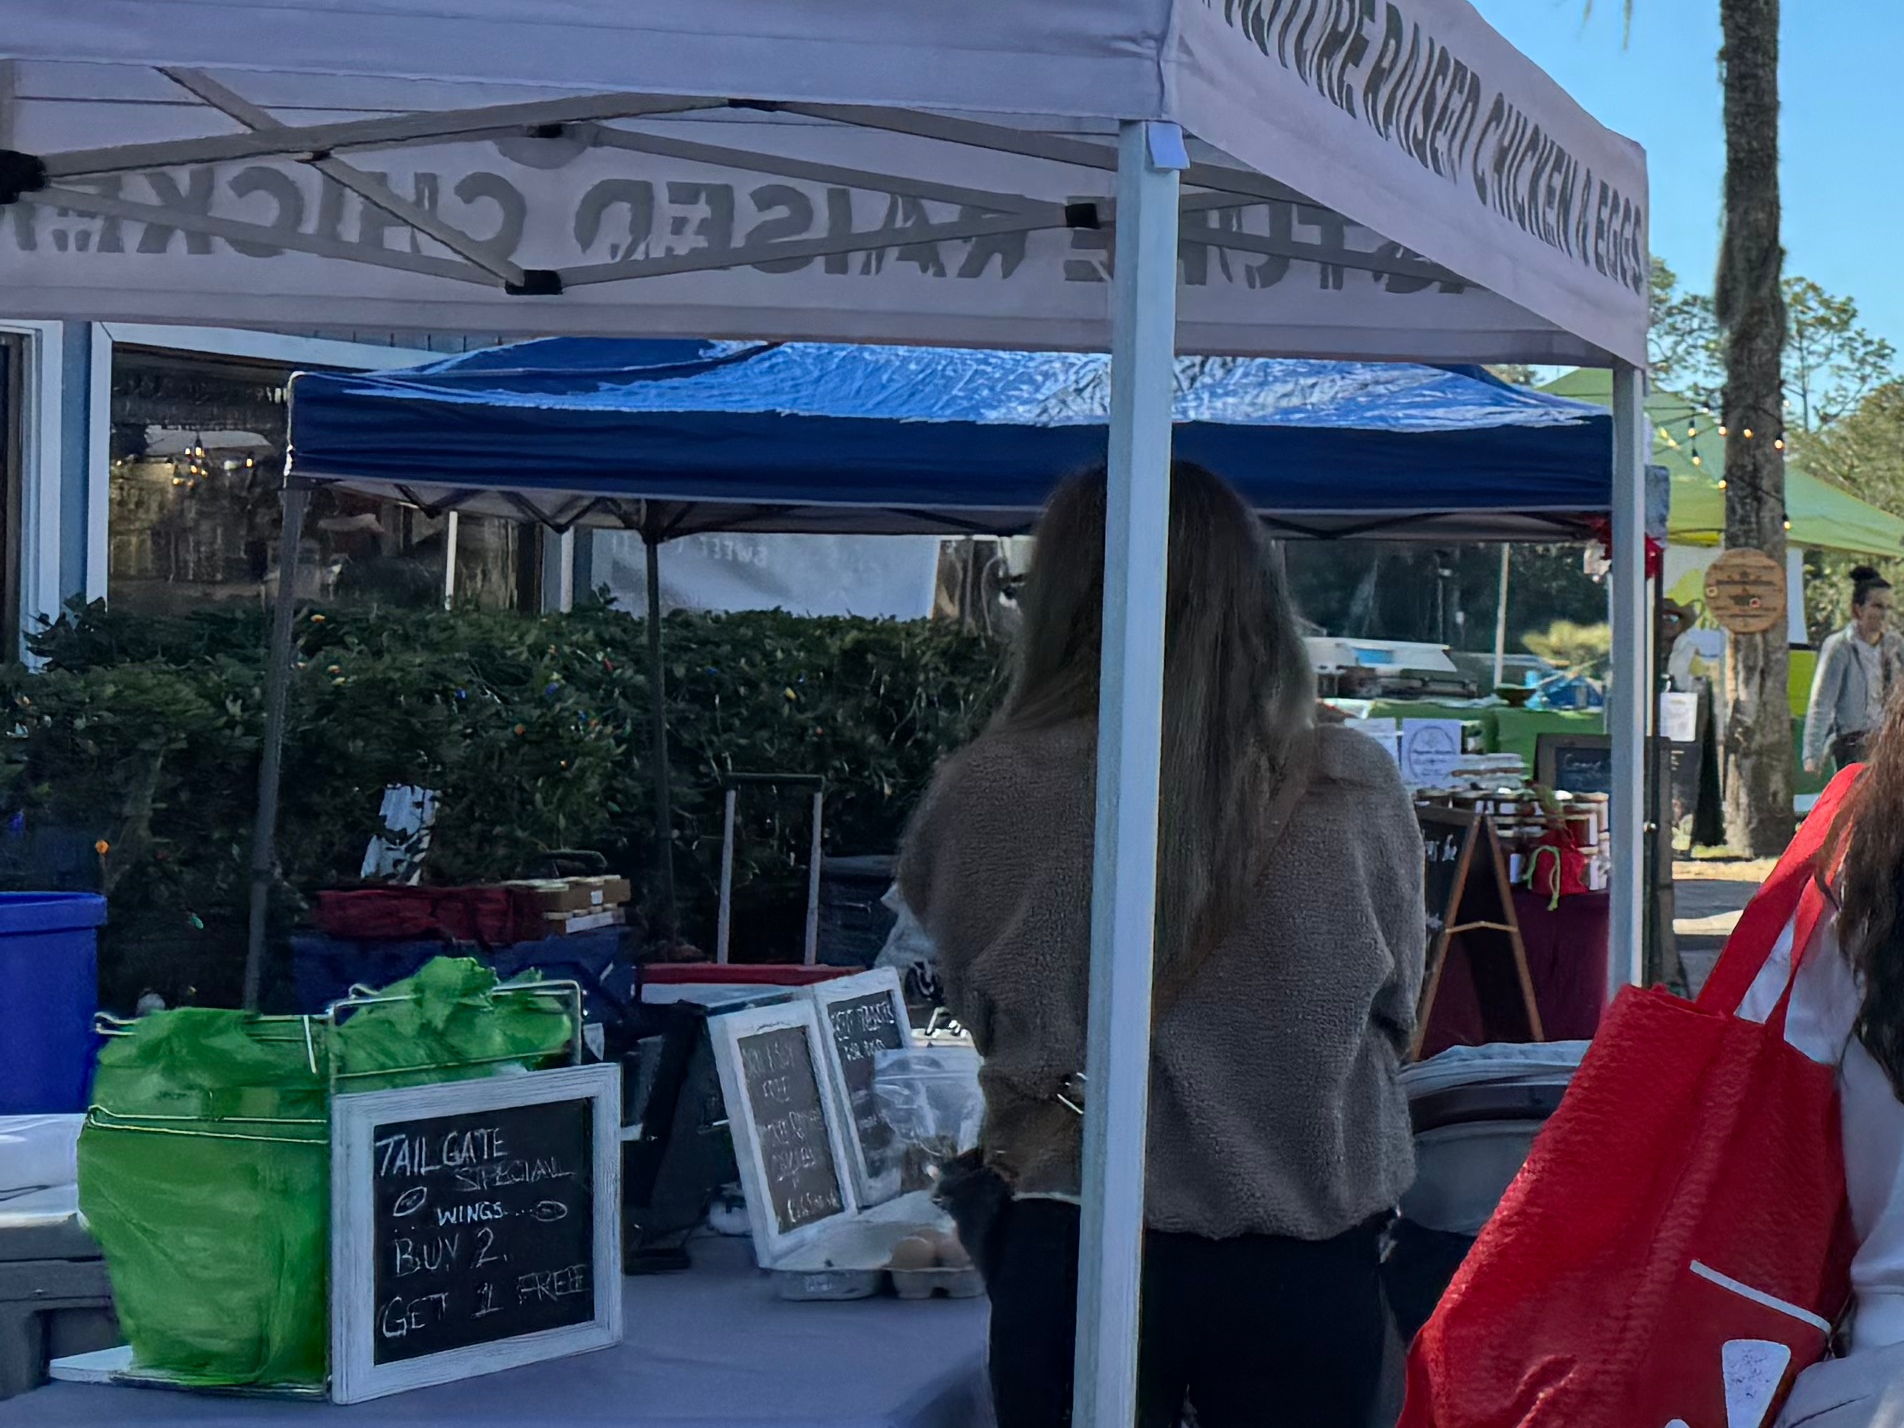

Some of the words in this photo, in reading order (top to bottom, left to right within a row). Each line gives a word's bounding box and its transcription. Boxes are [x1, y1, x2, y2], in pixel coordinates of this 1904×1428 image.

[1363, 1, 1481, 185] RAISED
[1472, 92, 1579, 258] CHICKEN
[1593, 180, 1645, 296] EGGS
[393, 1233, 460, 1277] BUY
[382, 1291, 449, 1339] GET
[470, 1282, 504, 1319] 1
[515, 1264, 590, 1305] FREE
